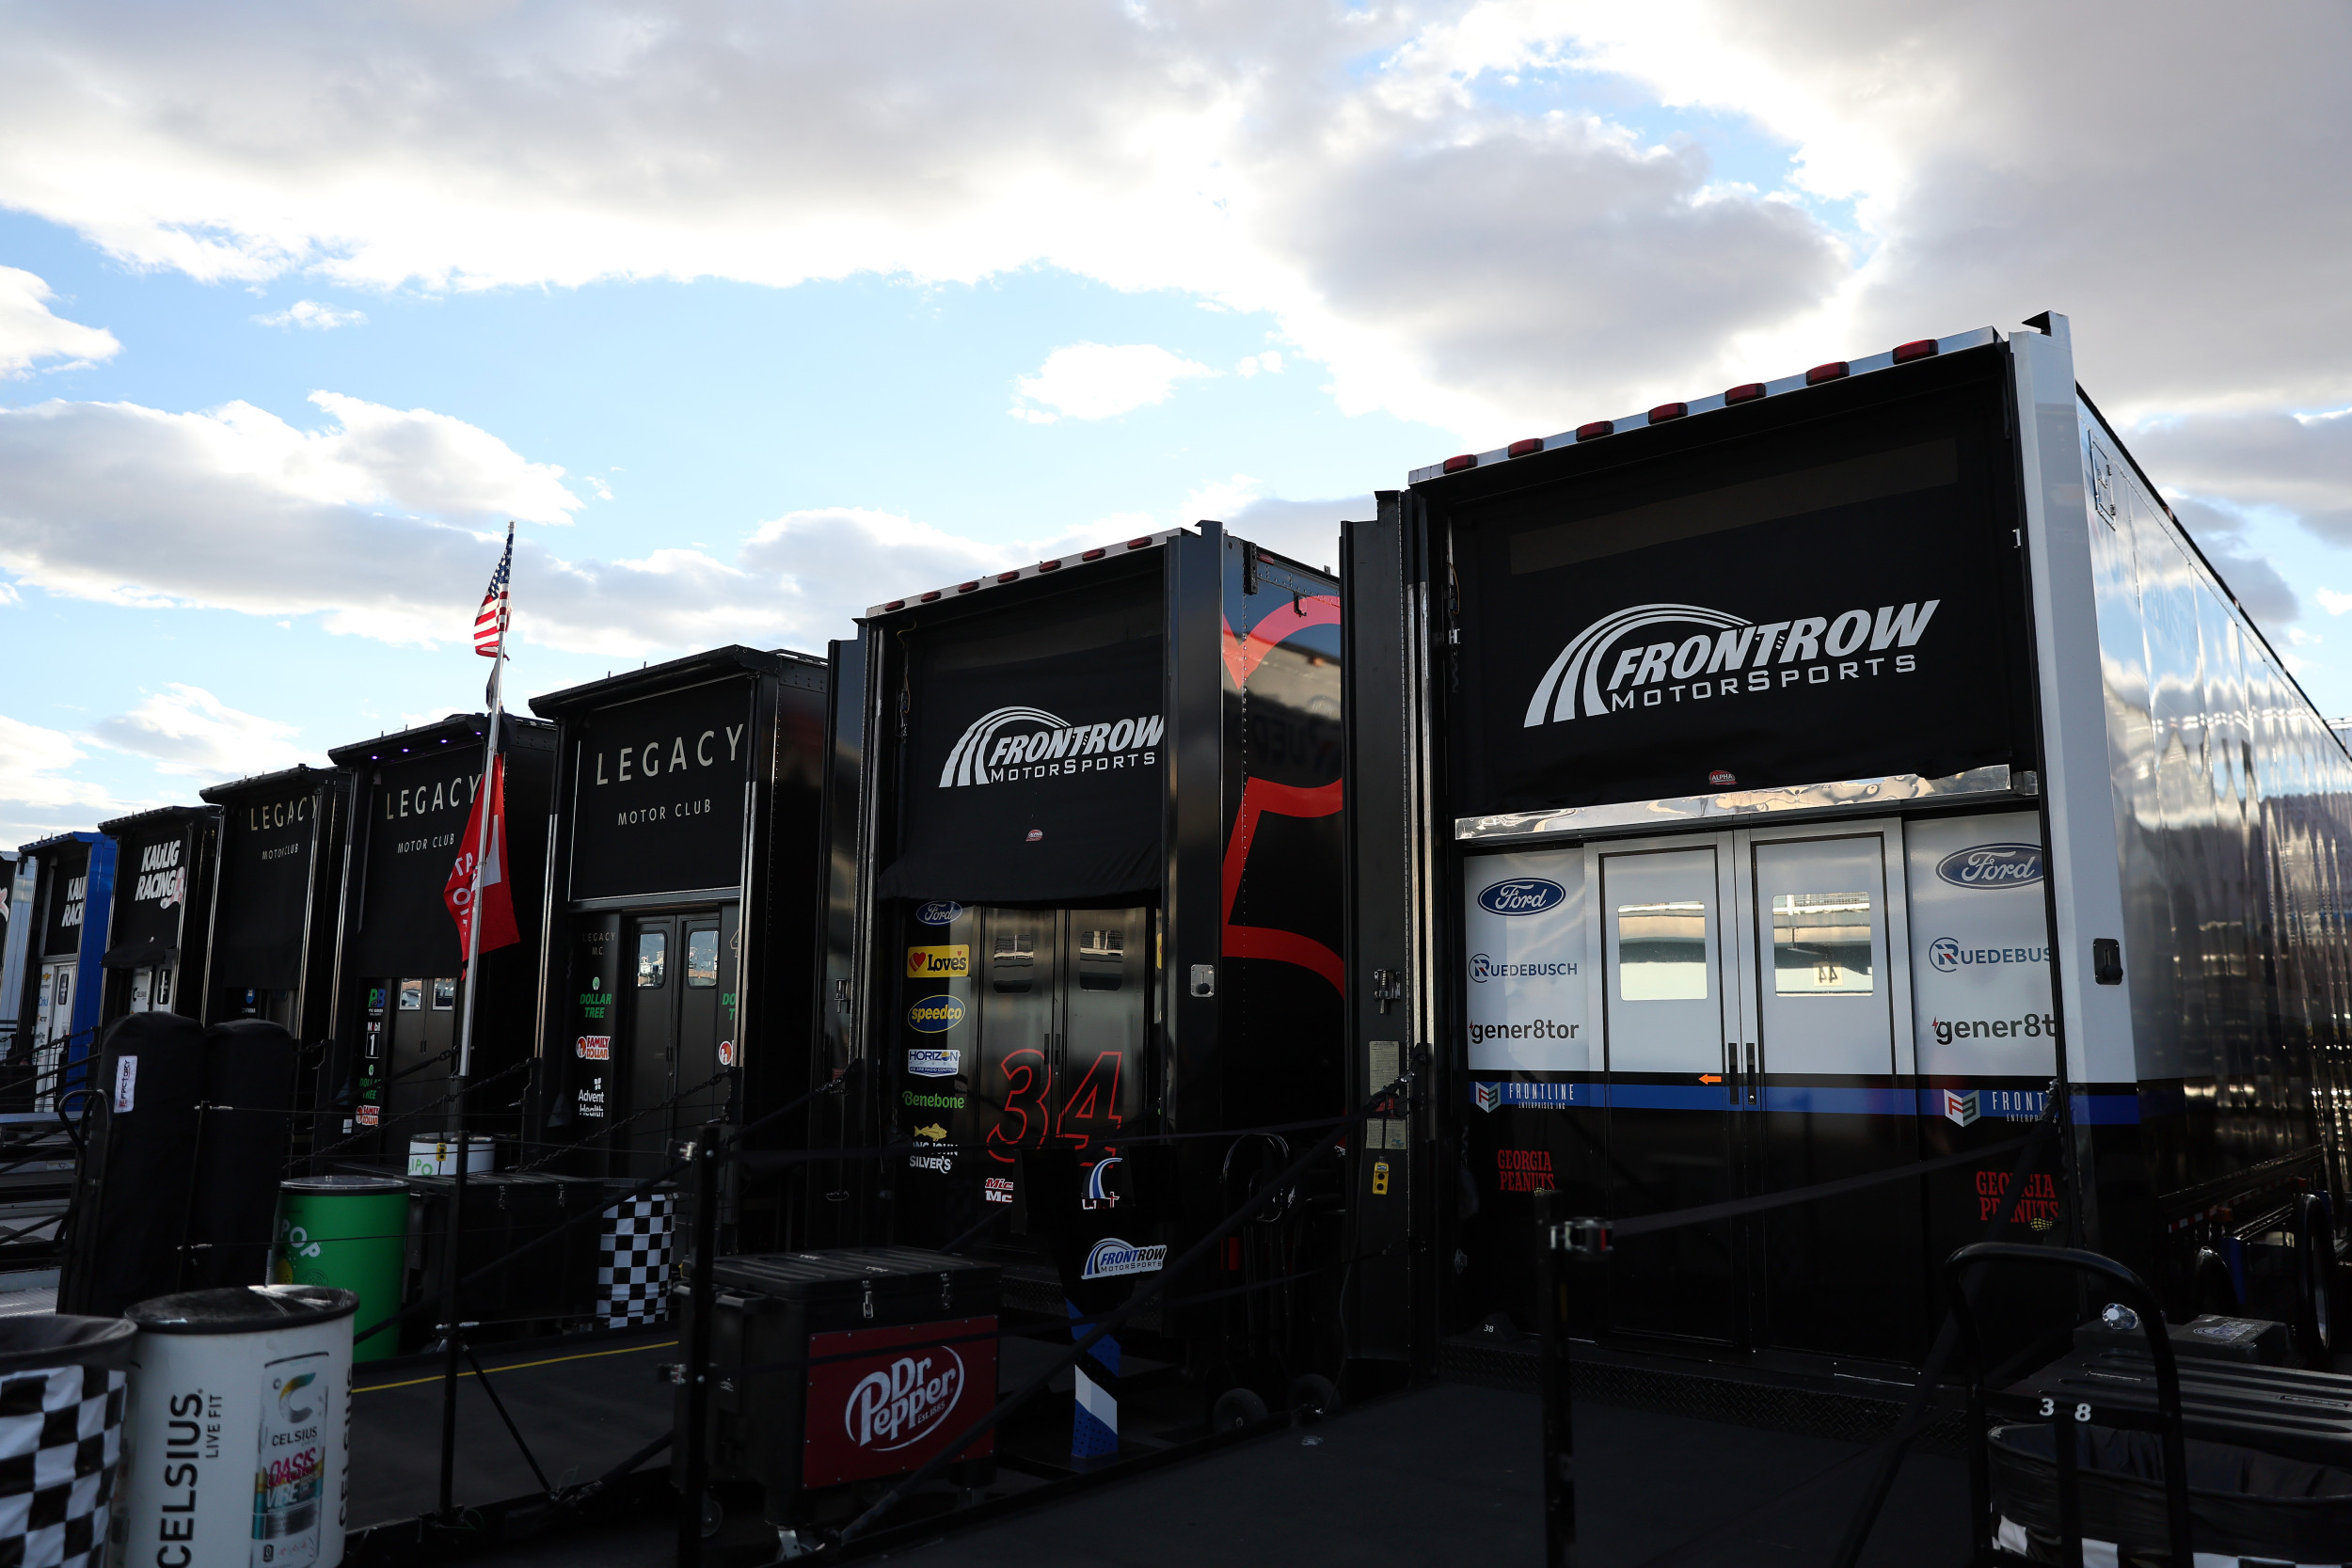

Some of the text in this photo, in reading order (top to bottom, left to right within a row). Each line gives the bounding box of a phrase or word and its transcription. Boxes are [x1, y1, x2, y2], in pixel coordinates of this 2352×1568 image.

[596, 722, 744, 785] LEGACY
[386, 773, 482, 820] LEGACY
[617, 798, 711, 826] MOTOR CLUB
[397, 832, 455, 854] MOTOR CLUB
[1961, 850, 2036, 882] Ford
[135, 869, 176, 901] RACING
[1495, 884, 1548, 910] Ford
[925, 903, 955, 922] Ford
[582, 931, 616, 942] LEGACY
[1472, 958, 1578, 977] RUEDEBUSCH
[580, 993, 612, 1006] DOLLAR
[584, 1006, 605, 1019] TREE
[911, 1004, 962, 1023] speedco
[586, 1037, 609, 1049] FAMILY
[1471, 1019, 1580, 1044] gener8tor
[370, 1034, 376, 1057] 1
[586, 1049, 609, 1059] DOLLAR
[910, 1051, 958, 1062] HORIZON
[578, 1088, 605, 1103] Advent
[902, 1090, 965, 1109] Benebone
[1508, 1083, 1574, 1101] FRONTLINE
[579, 1103, 605, 1118] Health
[986, 1049, 1122, 1167] 34
[1518, 1101, 1554, 1110] ENTERPRISES
[909, 1155, 952, 1174] SILVER'S
[1497, 1149, 1553, 1172] GEORGIA
[1499, 1170, 1557, 1192] PEANUTS
[1976, 1170, 2056, 1198] GEOGIA
[1979, 1196, 2060, 1223] PENUTS
[891, 1356, 932, 1402] Dr
[845, 1368, 957, 1448] Pepper
[2039, 1397, 2091, 1422] 3 8
[206, 1394, 223, 1459] LIVE FIT
[272, 1426, 318, 1447] CELSIUS
[268, 1447, 316, 1488] OASIS
[157, 1393, 203, 1568] CELSIUS
[267, 1480, 299, 1509] VIBE
